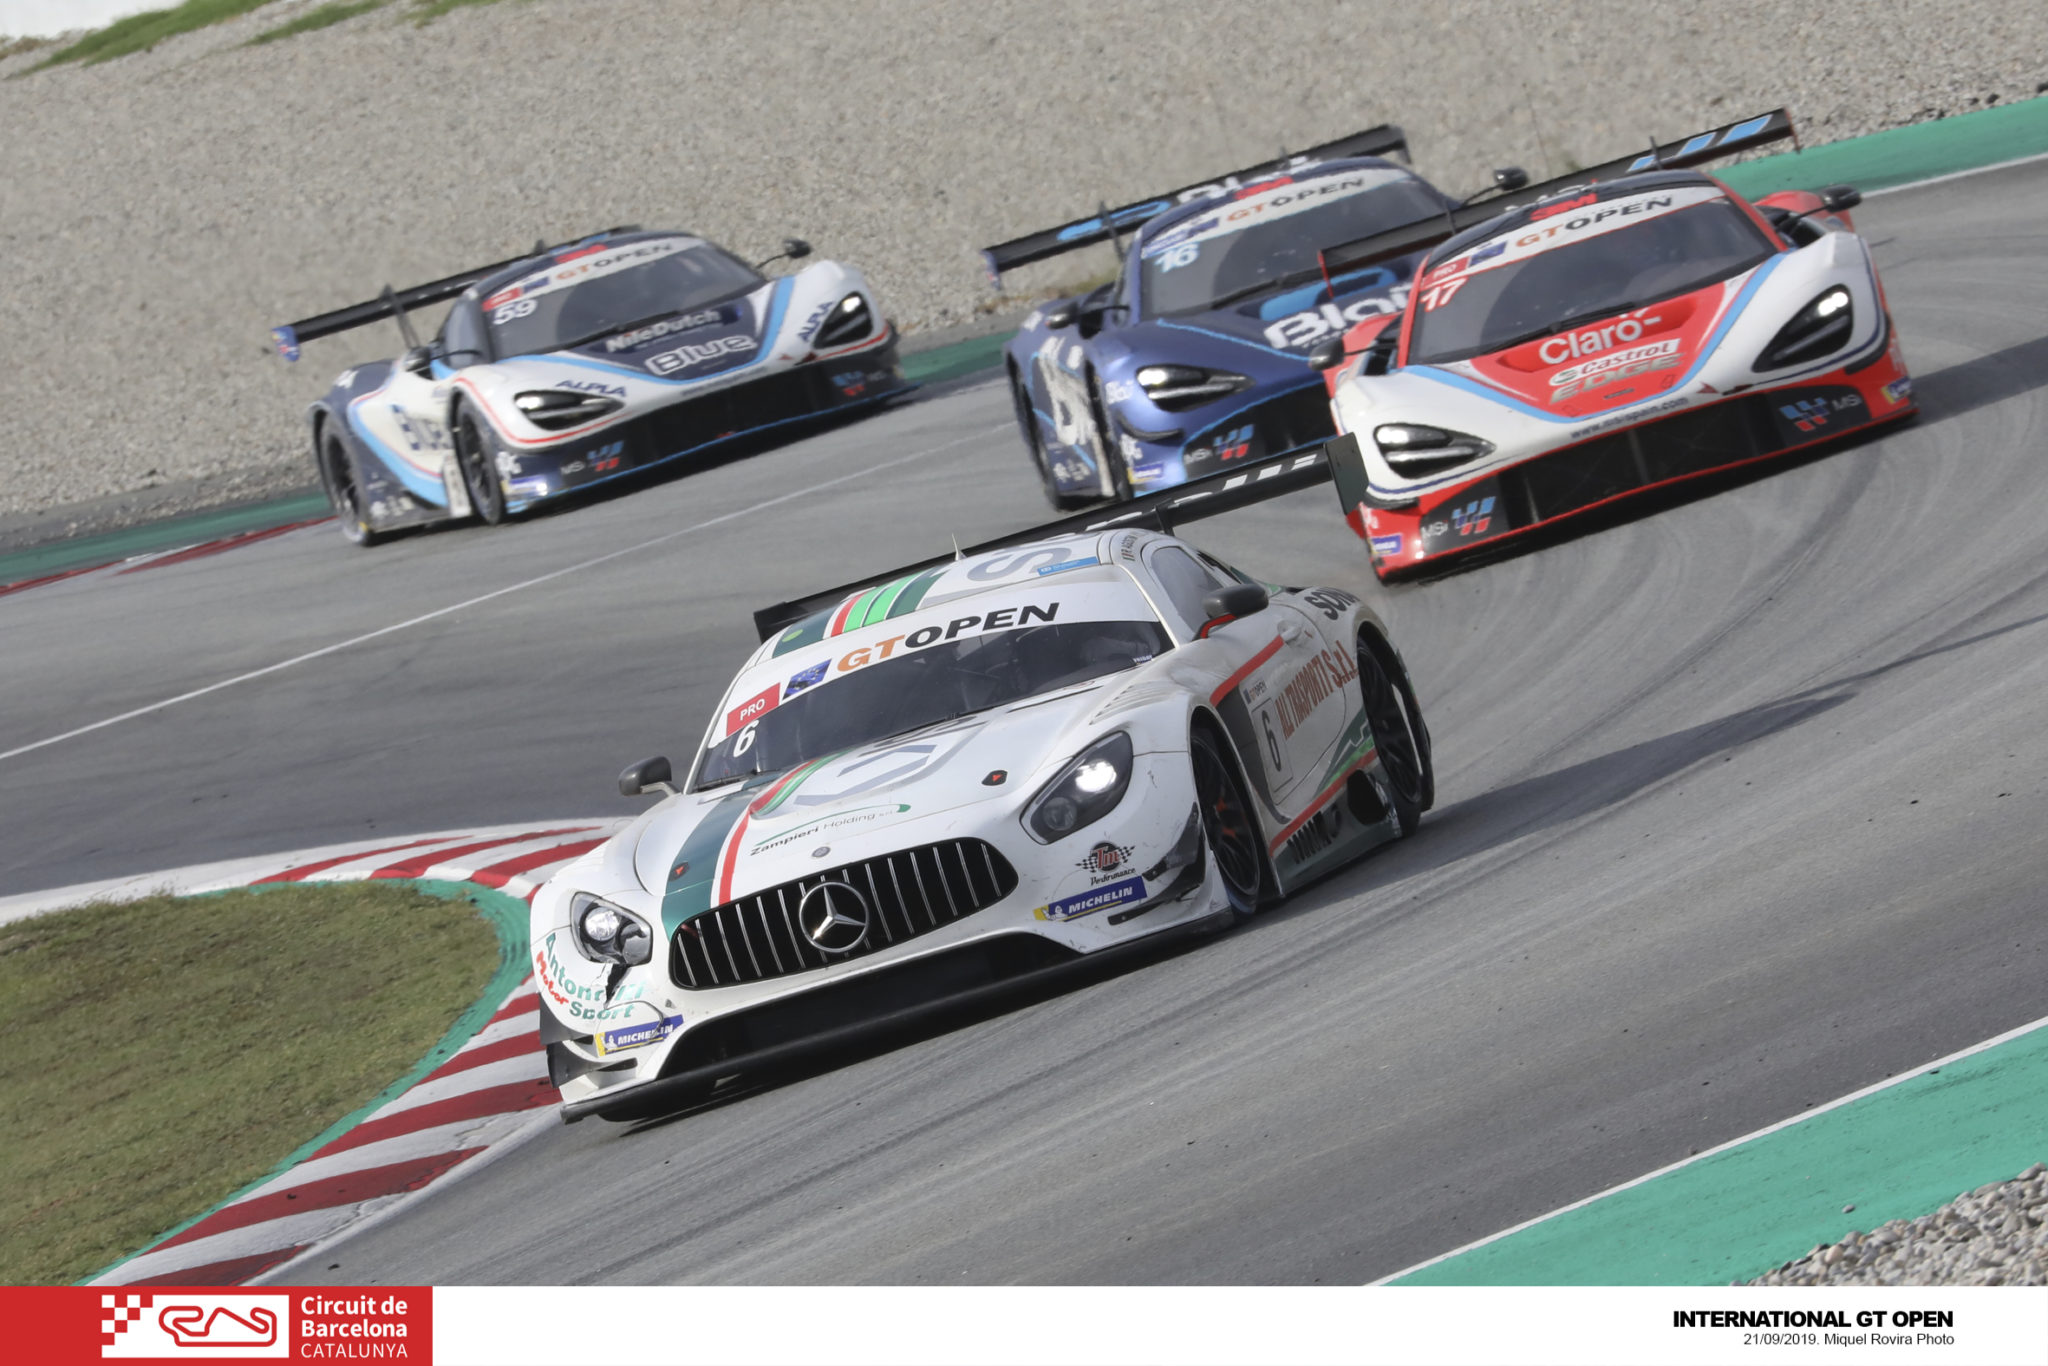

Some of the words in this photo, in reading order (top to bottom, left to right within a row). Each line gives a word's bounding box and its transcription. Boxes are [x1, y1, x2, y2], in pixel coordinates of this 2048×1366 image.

[1154, 243, 1200, 273] 16
[493, 299, 539, 325] 59
[1420, 276, 1468, 312] 17
[645, 335, 758, 376] Blue
[1581, 341, 1672, 376] Castrol
[1550, 353, 1685, 404] EDGE
[739, 697, 765, 722] PRO
[732, 719, 760, 758] 6
[1261, 709, 1282, 772] 6
[750, 824, 820, 857] Zampieri
[823, 812, 877, 832] Holding
[1068, 885, 1134, 915] MICHELIN
[536, 950, 570, 1006] Motor
[569, 1000, 635, 1021] Sport
